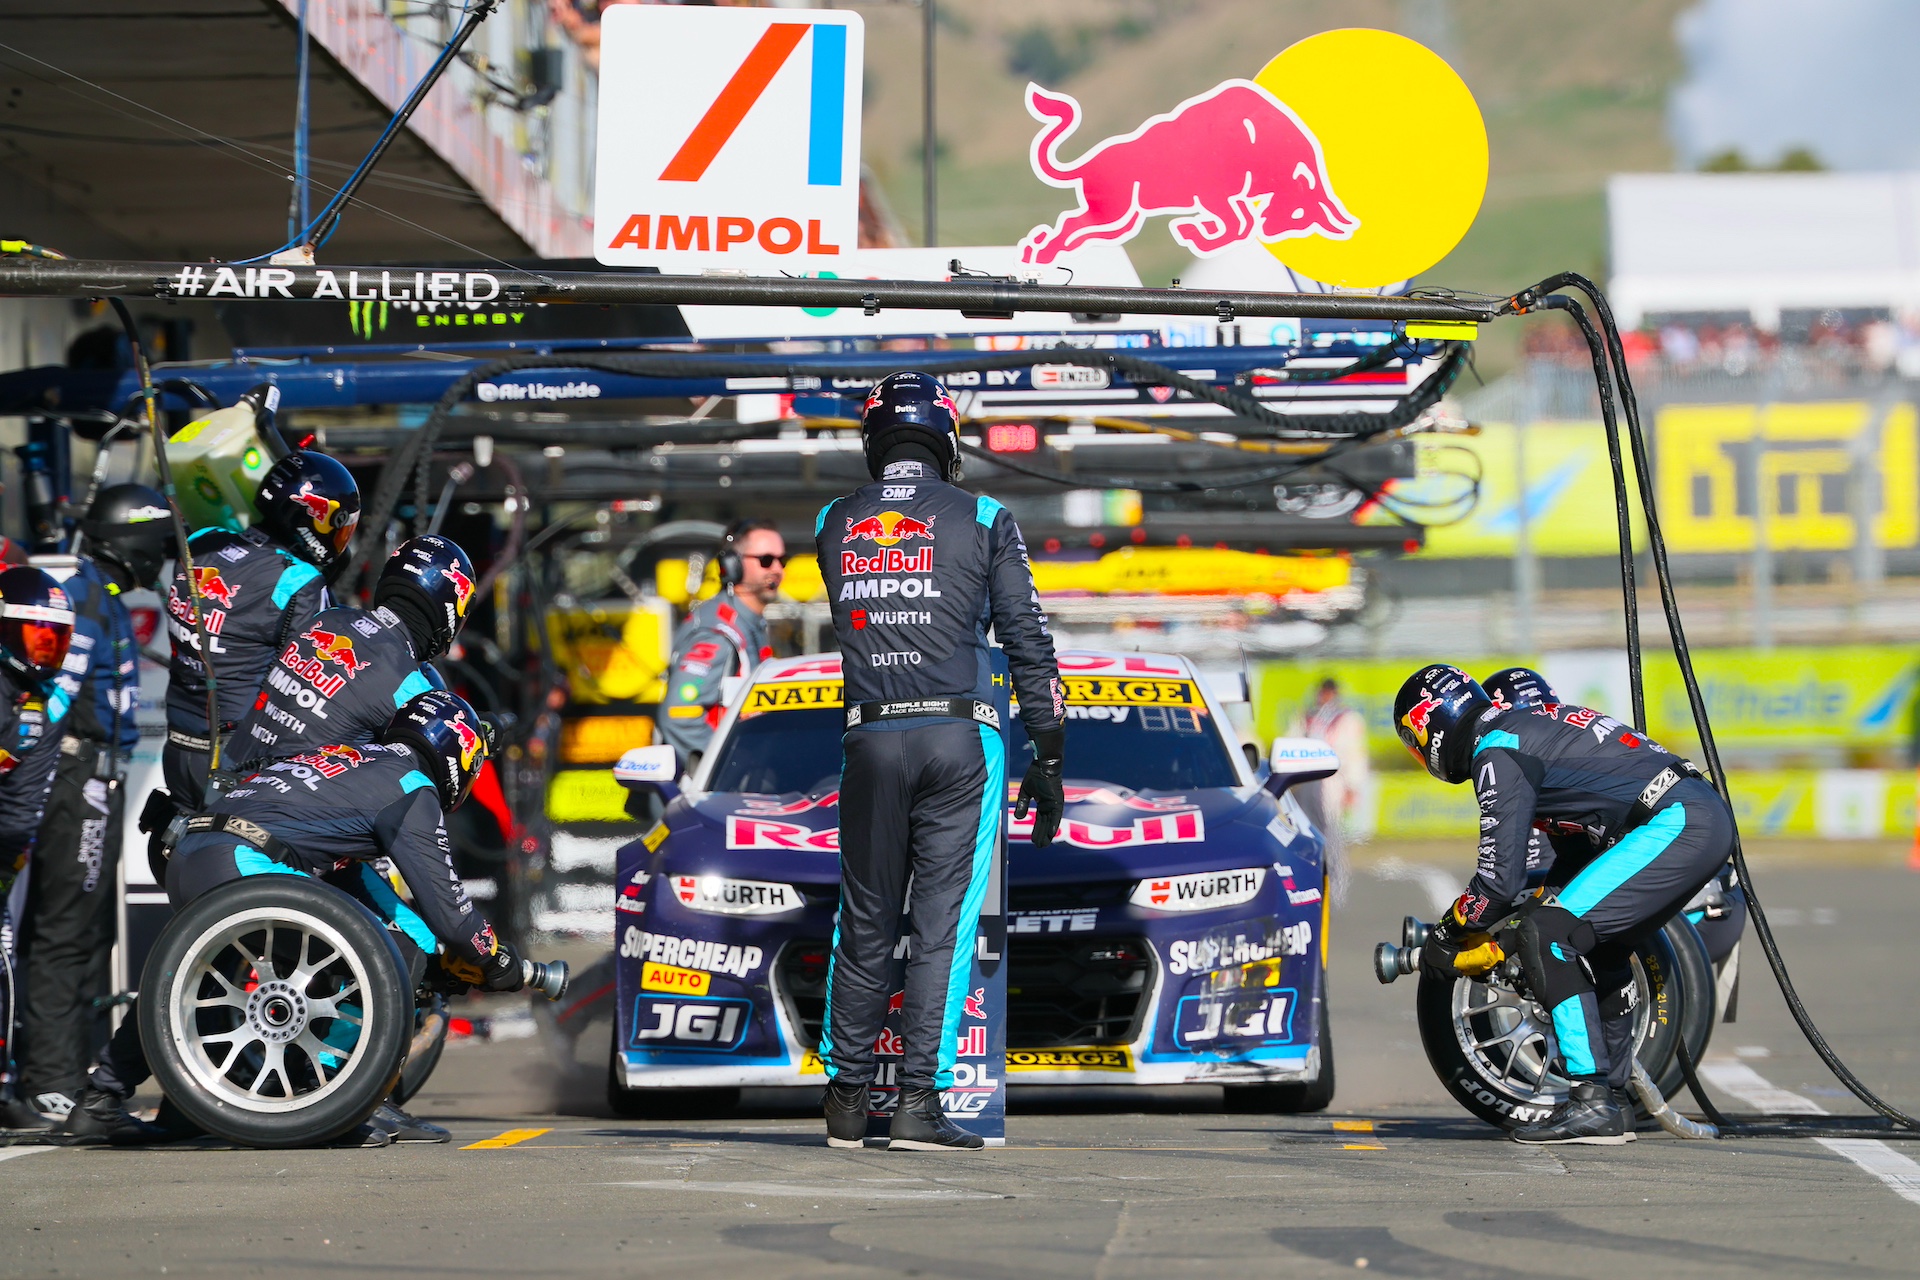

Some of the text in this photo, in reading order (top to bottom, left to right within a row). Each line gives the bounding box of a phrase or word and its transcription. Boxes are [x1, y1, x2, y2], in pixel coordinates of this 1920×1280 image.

[608, 214, 839, 255] AMPOL
[174, 266, 500, 301] #AIR ALLIED
[416, 312, 525, 327] ENERGY
[986, 370, 1021, 386] BY
[499, 381, 601, 400] Air Liquide
[894, 405, 917, 413] Dutto
[882, 488, 916, 499] OMP
[296, 526, 328, 558] AMPOL
[841, 546, 933, 576] Red Bull
[839, 578, 941, 602] AMPOL
[354, 619, 379, 635] OMP
[871, 651, 922, 668] DUTTO
[250, 723, 279, 746] MITCH
[728, 818, 841, 851] Re
[620, 924, 763, 979] SUPERCHEAP
[650, 971, 702, 988] AUTO
[638, 1003, 740, 1043] JGI
[873, 1027, 904, 1055] Re
